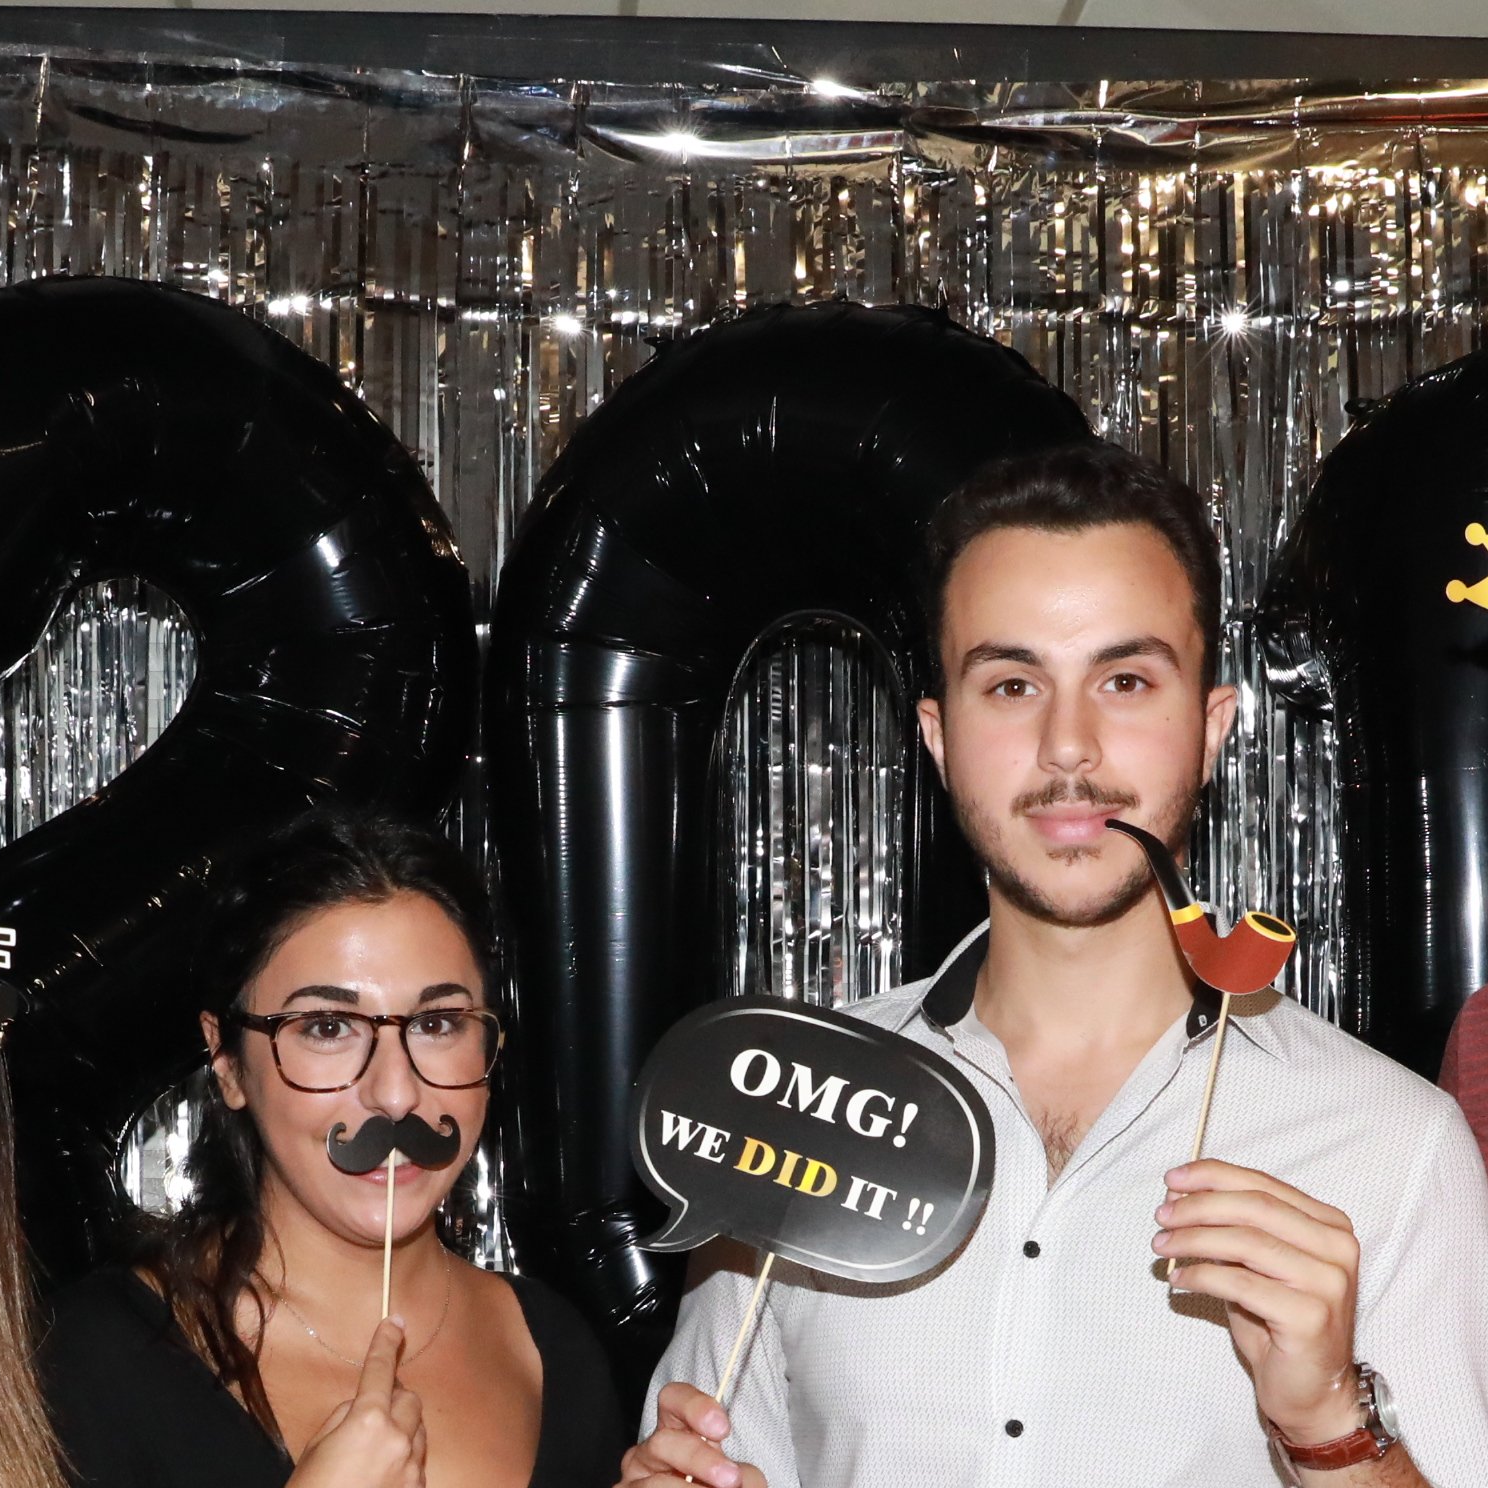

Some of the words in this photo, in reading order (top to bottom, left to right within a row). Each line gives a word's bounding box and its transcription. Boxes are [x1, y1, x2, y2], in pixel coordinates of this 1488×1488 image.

[729, 1048, 919, 1149] OMG!
[660, 1109, 731, 1164] WE
[733, 1136, 838, 1198] DID
